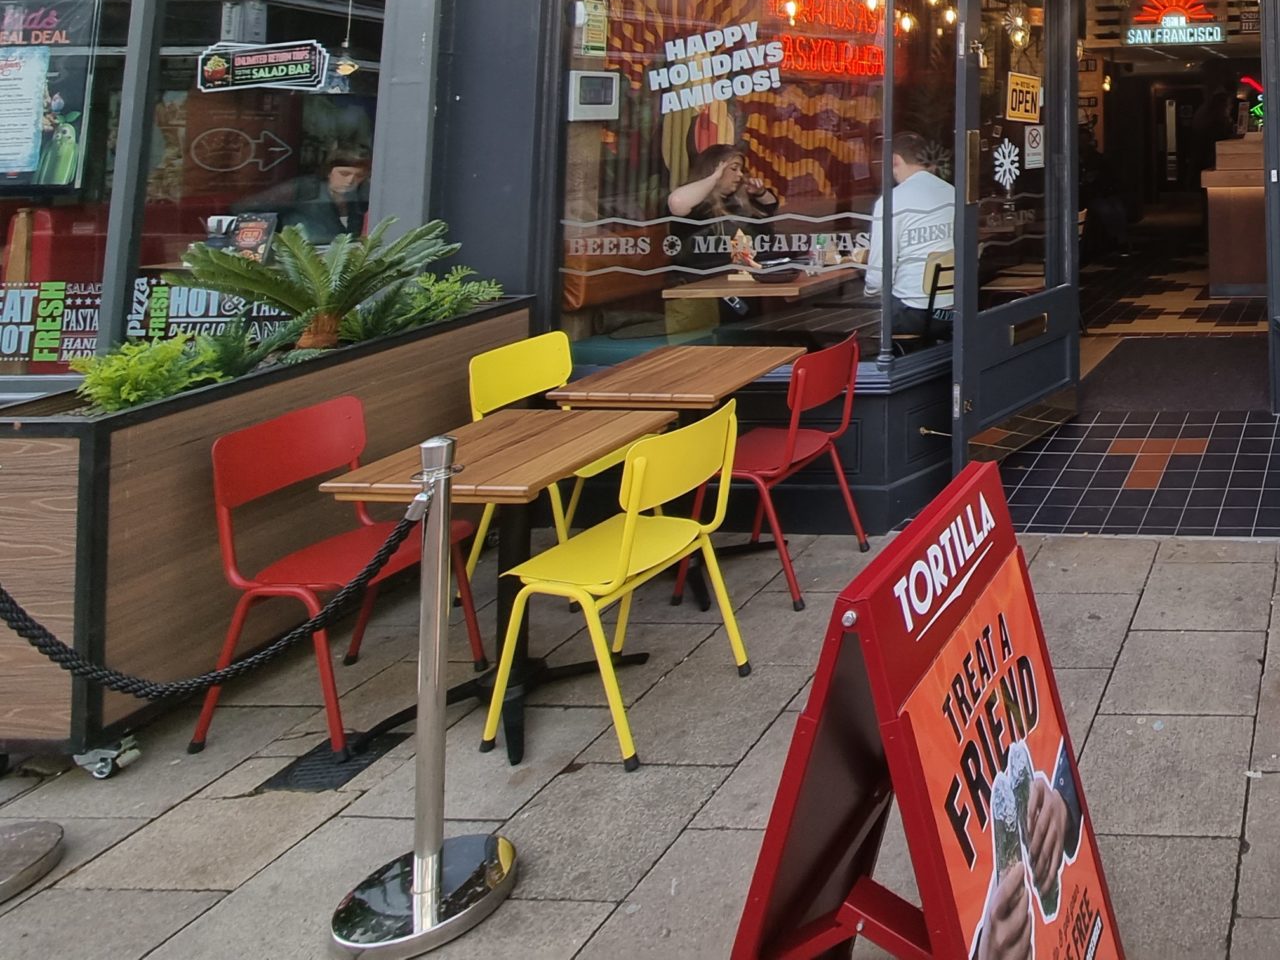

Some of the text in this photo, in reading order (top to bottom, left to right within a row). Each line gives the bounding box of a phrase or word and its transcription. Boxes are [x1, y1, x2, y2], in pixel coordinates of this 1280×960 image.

[31, 30, 70, 44] DEAL
[665, 21, 758, 62] HAPPY
[1127, 26, 1221, 44] SAN FRANCISCO
[252, 63, 310, 79] SALAD BAR
[649, 41, 784, 91] HOLIDAYS
[661, 67, 781, 114] AMIGOS!
[1011, 88, 1037, 114] OPEN
[568, 232, 871, 256] BEERS MARGARITAS
[33, 282, 66, 361] FRESH
[62, 309, 99, 331] PASTA
[127, 277, 149, 337] pizza
[149, 286, 169, 337] FRESH
[169, 286, 220, 317] HOT
[0, 325, 34, 354] OT
[169, 321, 236, 337] DELICIO
[893, 491, 996, 632] TORTILLA
[942, 612, 1014, 745] TREAT A
[944, 655, 1040, 872] FRIEND
[1072, 887, 1094, 960] FREE
